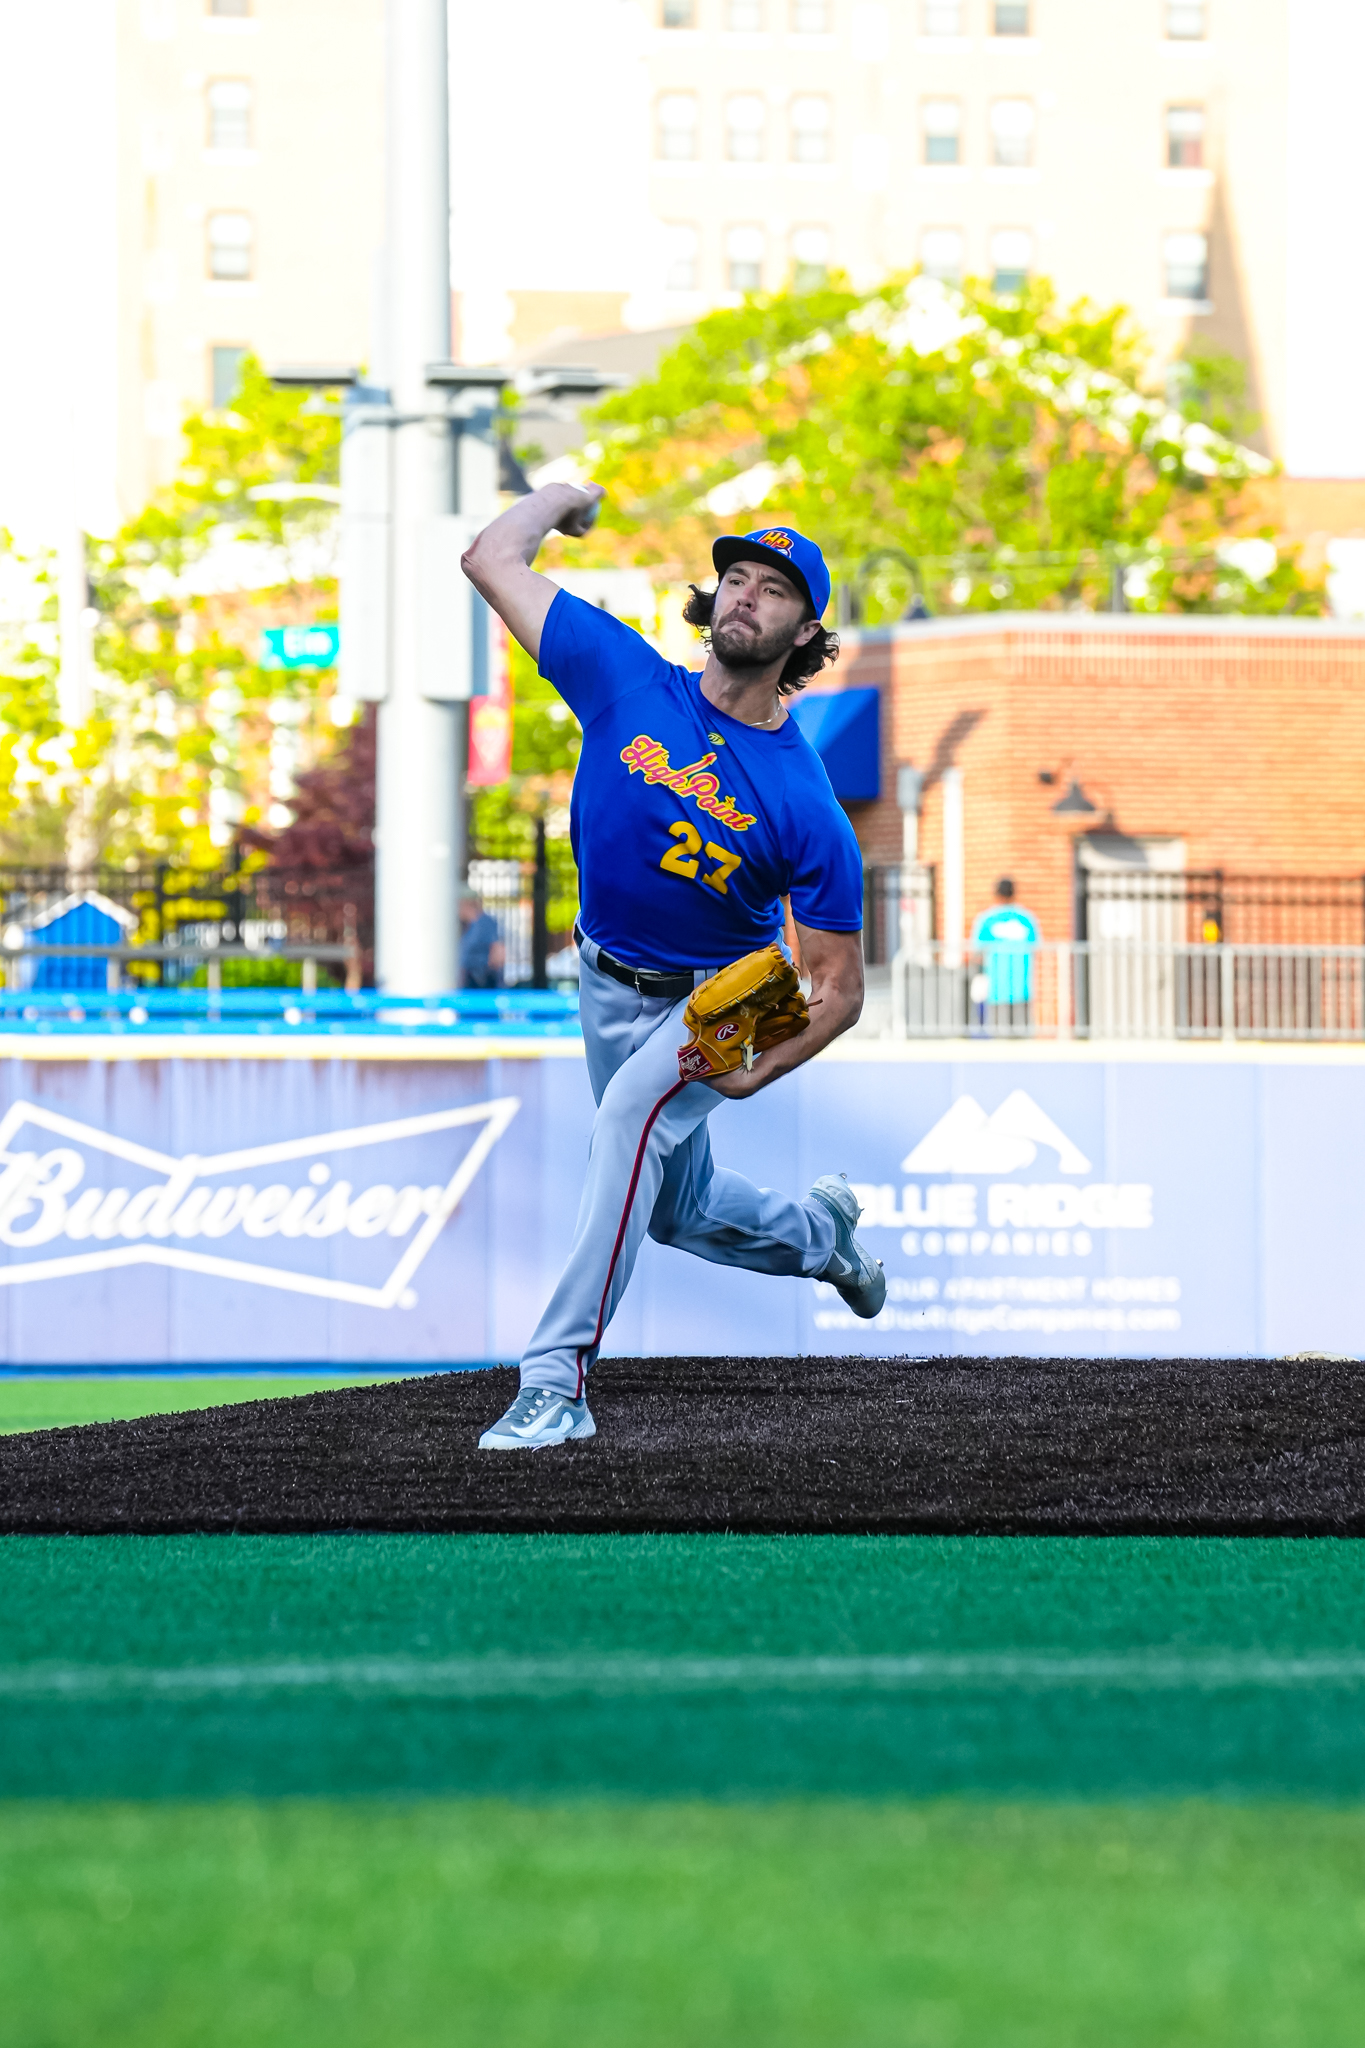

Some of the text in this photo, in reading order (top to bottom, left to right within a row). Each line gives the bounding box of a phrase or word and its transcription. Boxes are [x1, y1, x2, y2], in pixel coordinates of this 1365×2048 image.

[759, 531, 792, 549] HP
[620, 734, 757, 831] High Point
[660, 821, 742, 894] 27
[0, 1148, 452, 1247] Budweiser
[987, 1183, 1154, 1228] RIDGE
[901, 1231, 1092, 1256] COMPANIES
